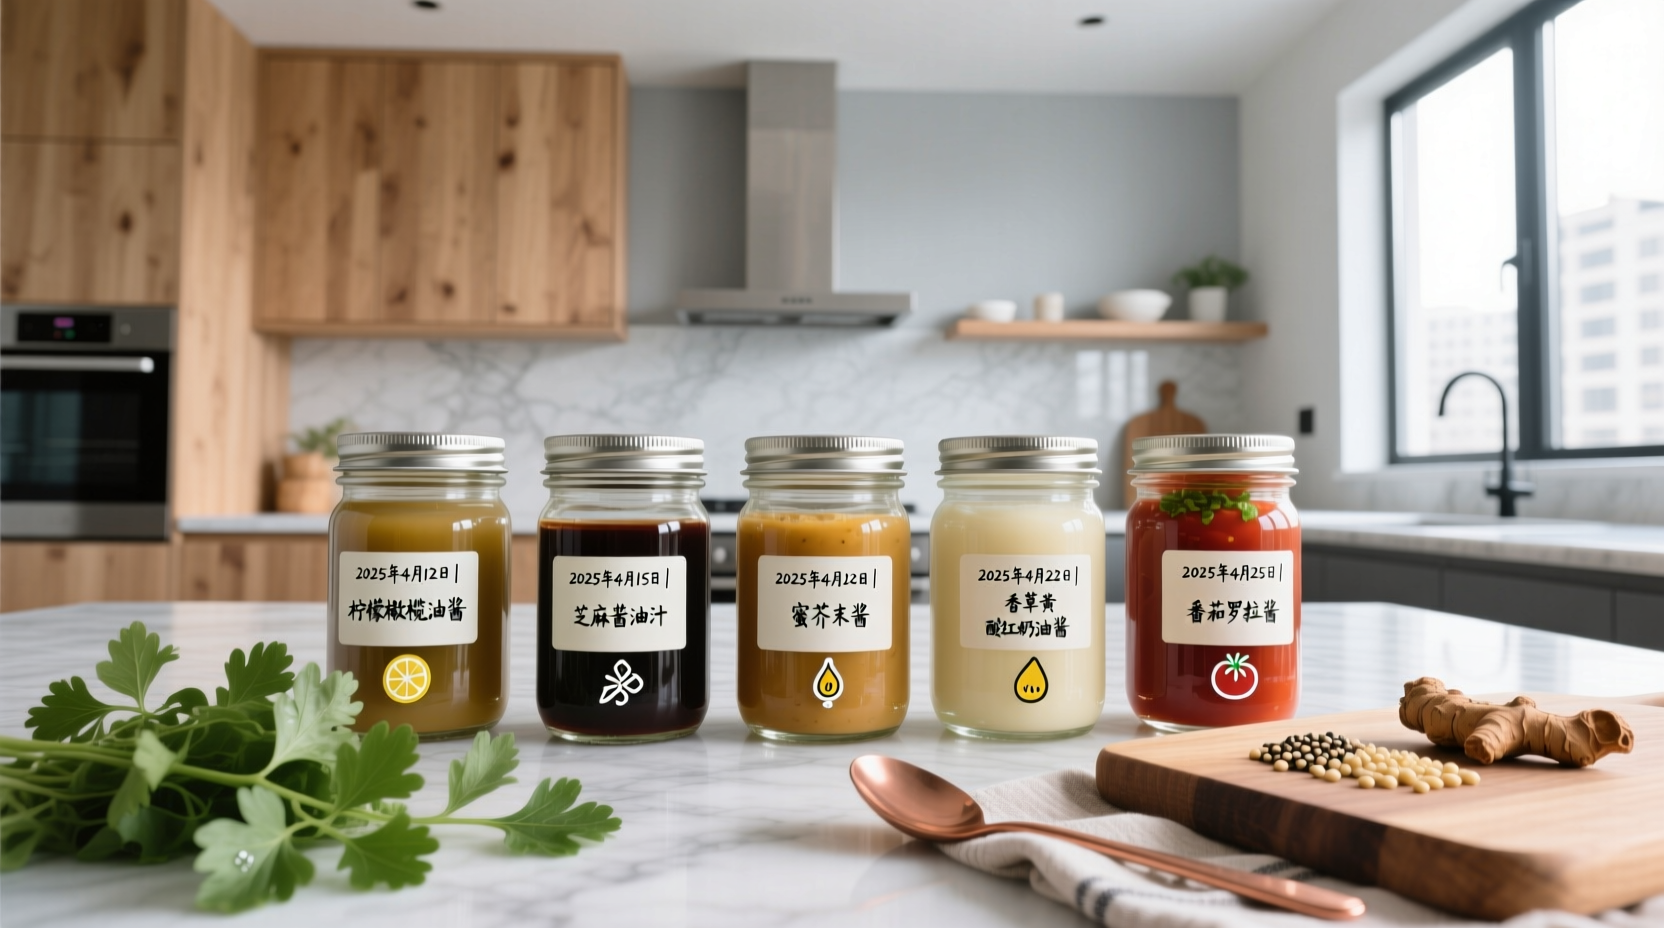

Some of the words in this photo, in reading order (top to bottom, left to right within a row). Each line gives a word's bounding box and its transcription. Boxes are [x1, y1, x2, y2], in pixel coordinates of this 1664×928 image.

[347, 596, 467, 623] 柠檬橄榄油酱
[791, 601, 870, 630] 蜜芥末酱
[1004, 592, 1057, 614] 香草黄
[1186, 599, 1280, 625] 番茄罗拉酱
